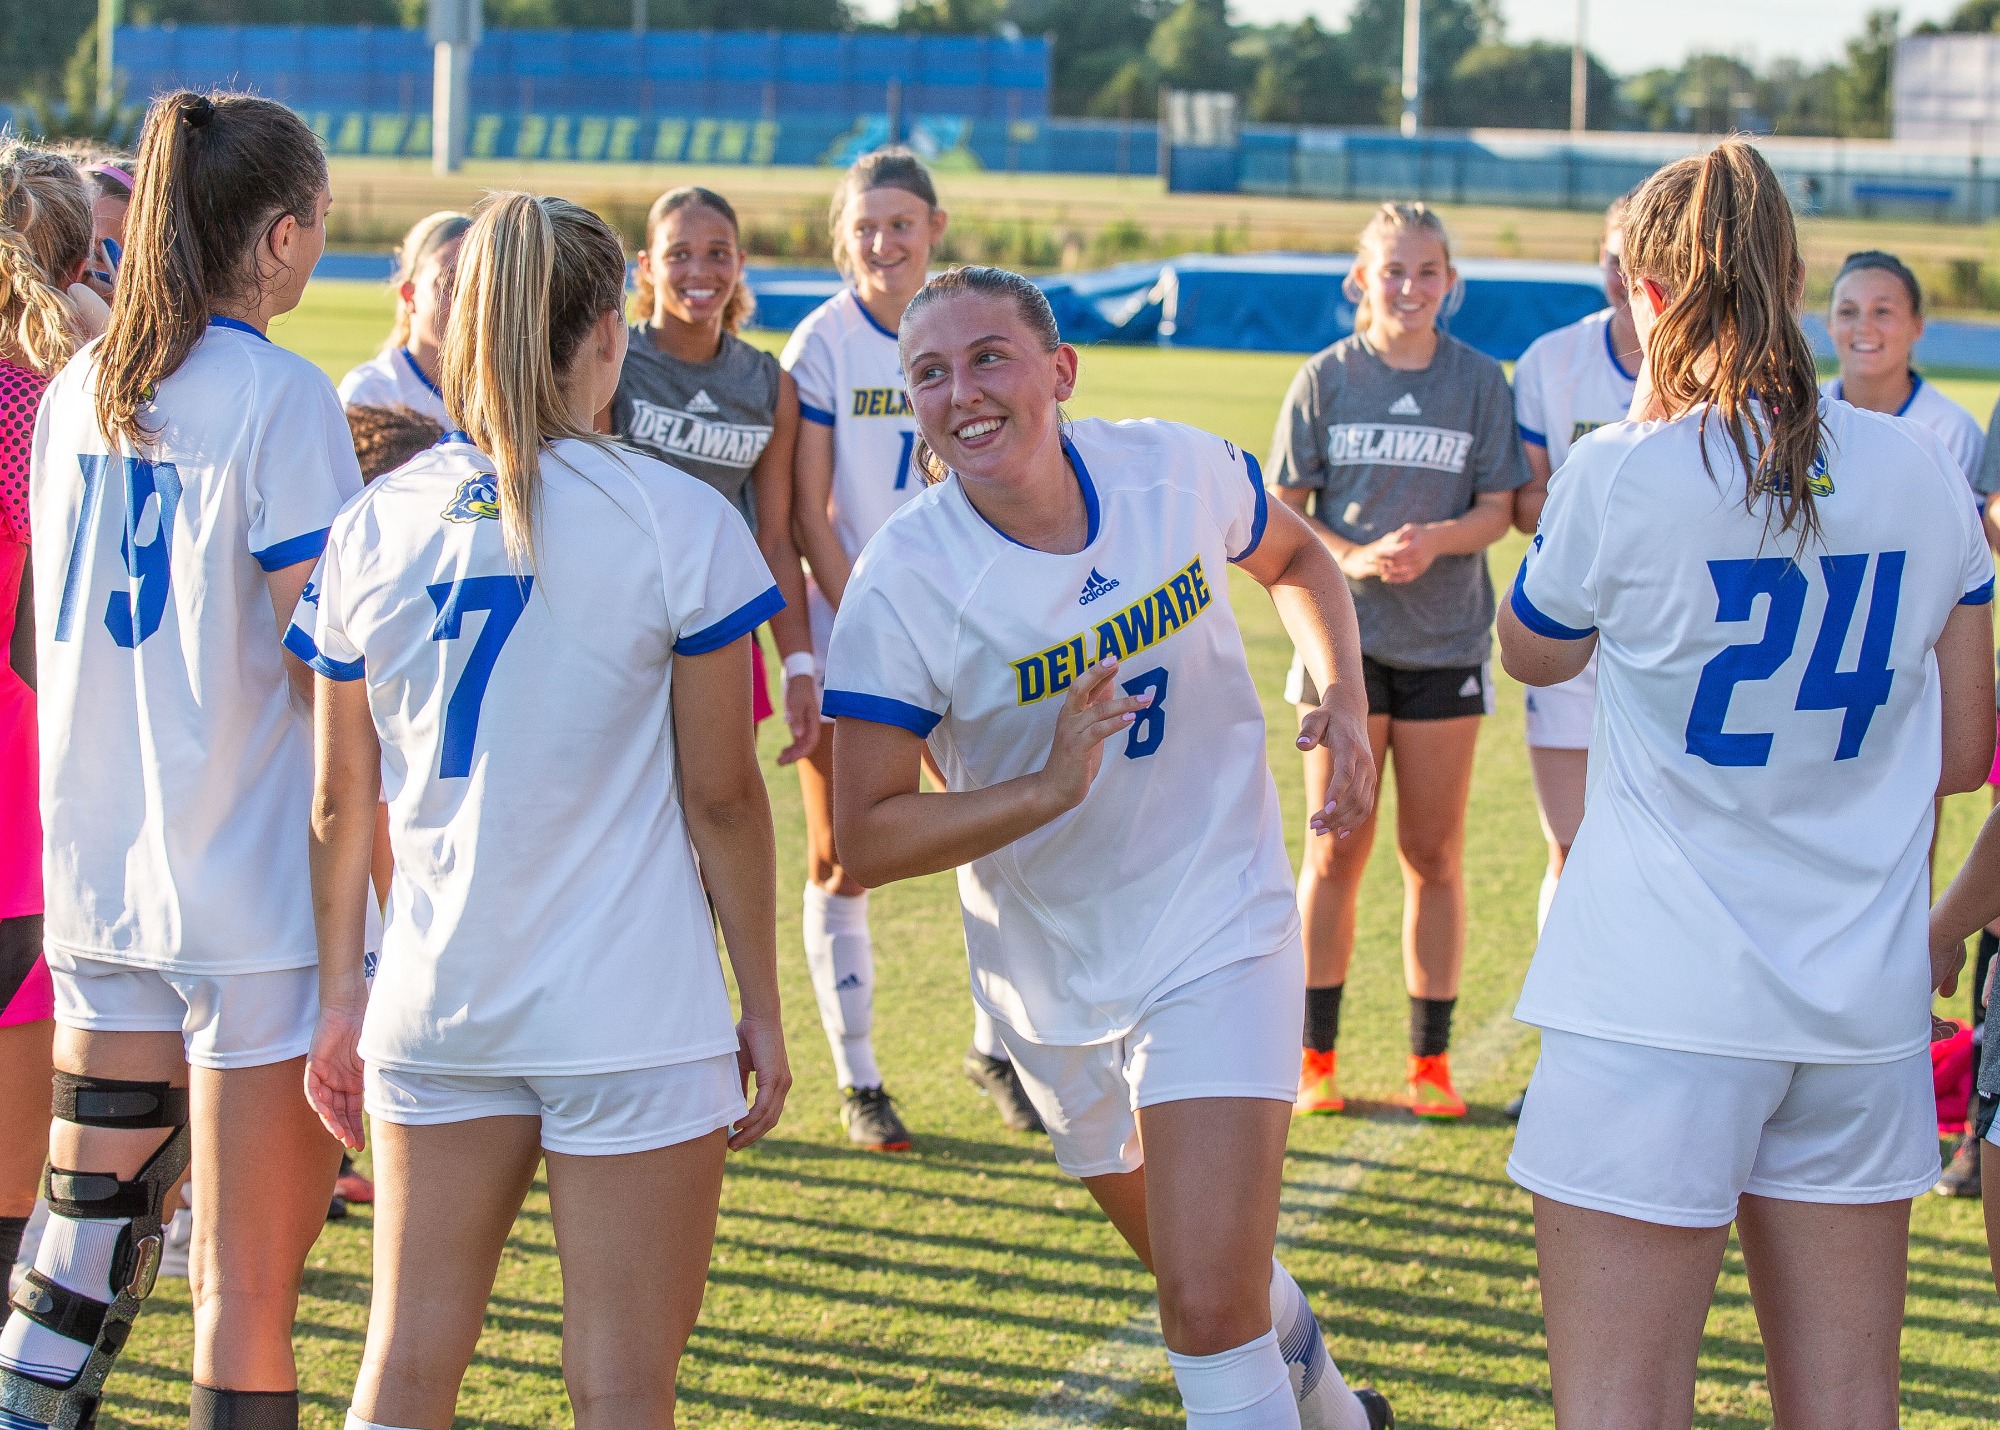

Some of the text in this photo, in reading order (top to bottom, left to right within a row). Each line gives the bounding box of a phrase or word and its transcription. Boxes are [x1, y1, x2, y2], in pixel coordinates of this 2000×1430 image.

[853, 388, 911, 417] DELA
[633, 404, 771, 464] DELAWARE
[894, 430, 928, 490] 1
[1330, 428, 1469, 467] DELAWARE
[54, 453, 184, 650] 19
[1078, 578, 1120, 606] adidas
[1014, 557, 1211, 704] DELAWARE
[1685, 550, 1906, 767] 24
[426, 575, 535, 779] 7
